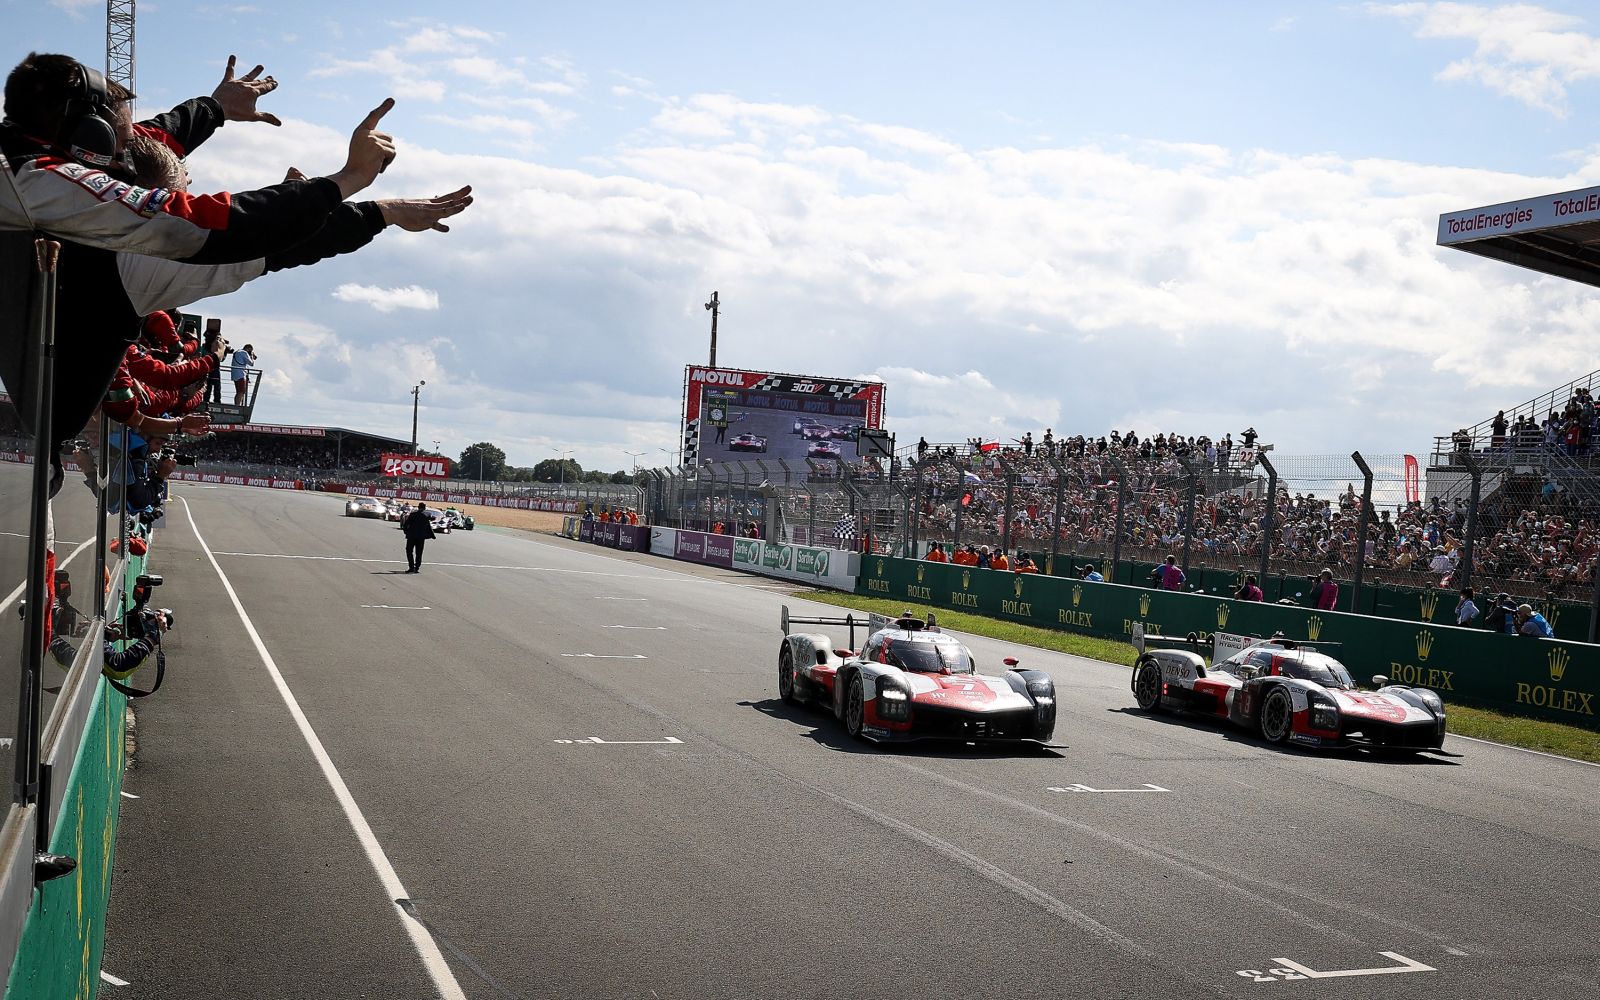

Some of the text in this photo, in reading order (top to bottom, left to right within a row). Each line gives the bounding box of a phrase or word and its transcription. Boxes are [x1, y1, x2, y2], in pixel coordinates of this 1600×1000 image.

[1447, 207, 1533, 234] TotalEnergies
[691, 369, 744, 386] MOTUL
[791, 382, 826, 394] 300V
[1240, 451, 1253, 462] 22
[384, 458, 446, 476] MOTUL
[202, 474, 221, 483] MOTUL
[224, 475, 244, 485] MOTUL
[248, 477, 269, 487] MOTUL
[272, 479, 295, 489] MOTUL
[346, 486, 370, 495] MOTUL
[374, 488, 397, 497] MOTUL
[400, 490, 422, 500] MOTUL
[425, 492, 445, 501] MOTUL
[447, 494, 466, 504] MOTUL
[735, 541, 748, 554] Sarthe
[765, 546, 779, 560] Sarthe
[798, 550, 814, 565] Sarthe
[868, 578, 890, 593] ROLEX
[907, 584, 931, 600] ROLEX
[952, 591, 978, 608] ROLEX
[1002, 599, 1032, 617] ROLEX
[1058, 608, 1092, 628] ROLEX
[1220, 634, 1242, 643] RACING
[1166, 665, 1190, 679] DENSO
[1390, 662, 1455, 691] ROLEX
[1516, 682, 1595, 715] ROLEX
